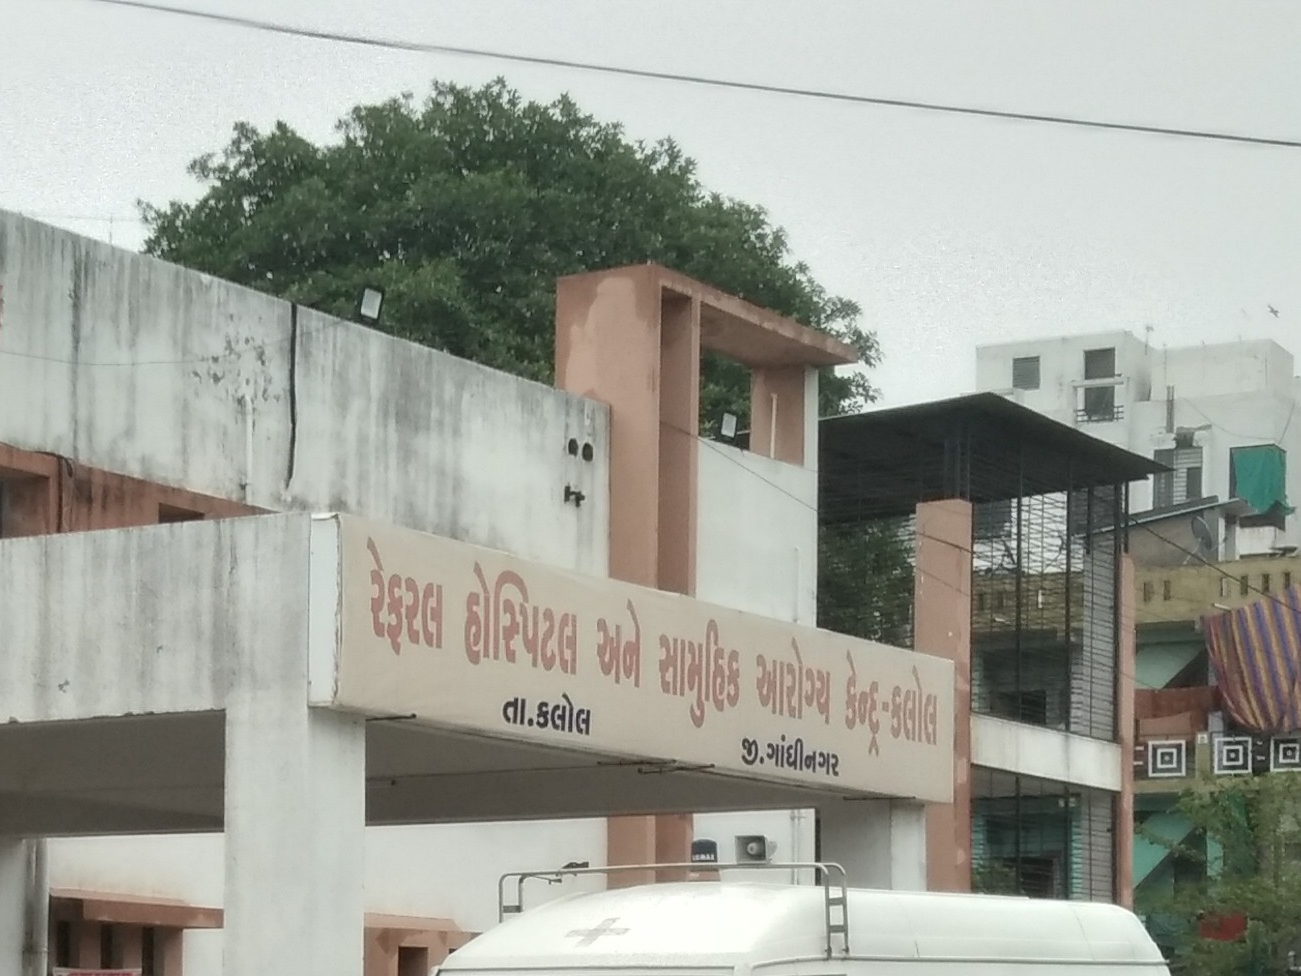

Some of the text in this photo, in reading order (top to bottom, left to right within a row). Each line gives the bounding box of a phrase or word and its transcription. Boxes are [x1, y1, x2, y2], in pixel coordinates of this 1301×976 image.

[366, 535, 444, 656] રેફરલ
[464, 560, 578, 676] હોસ્પિટલ
[597, 598, 641, 688] અને
[659, 618, 740, 728] સામુહિક
[756, 636, 831, 725] આરોગ્ય
[502, 692, 592, 736] તા.કલોલ
